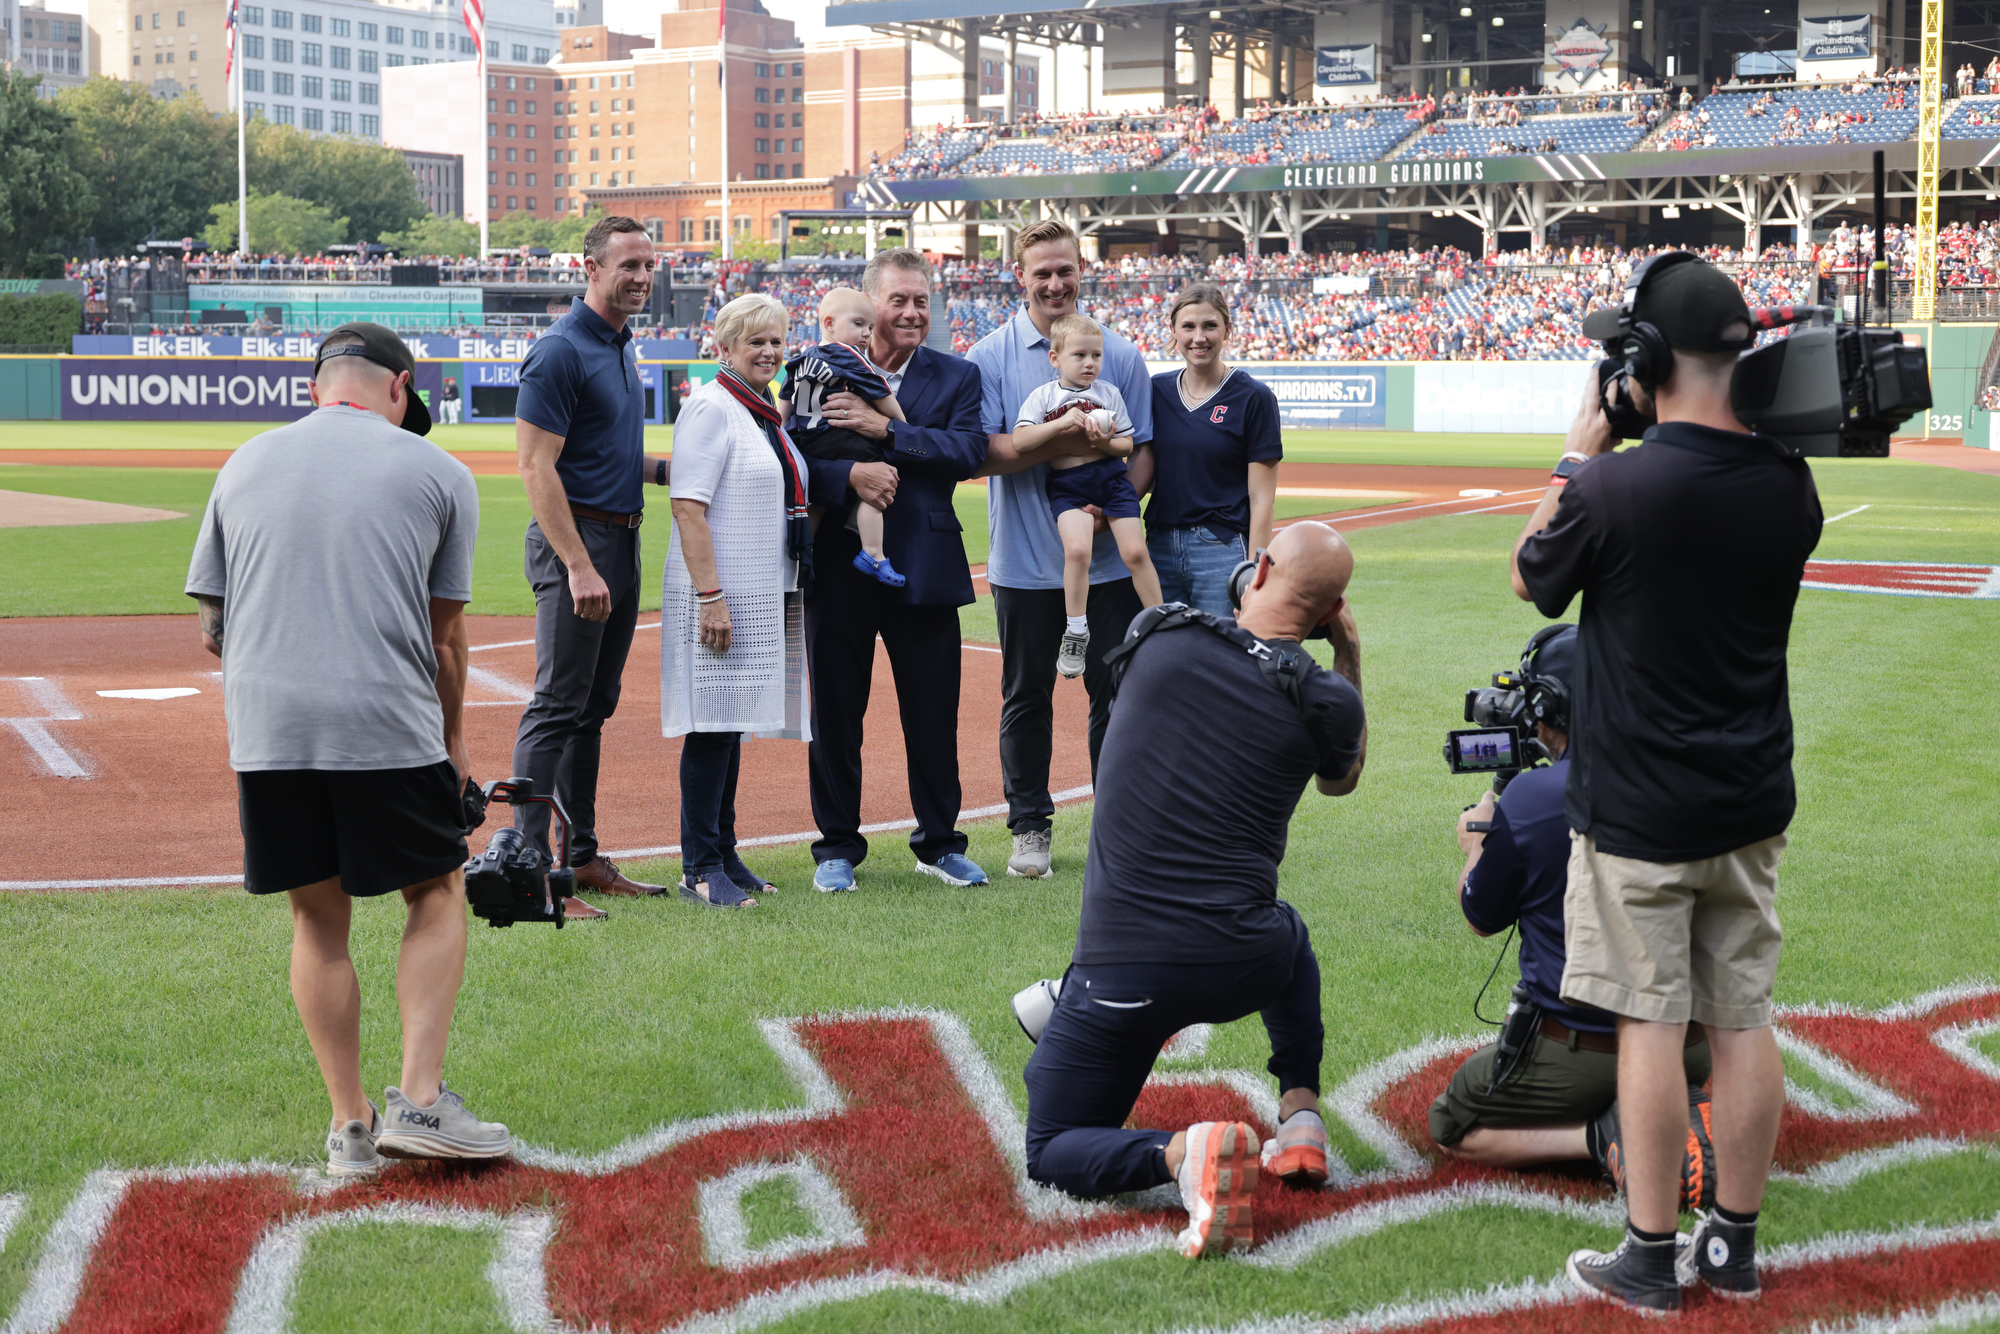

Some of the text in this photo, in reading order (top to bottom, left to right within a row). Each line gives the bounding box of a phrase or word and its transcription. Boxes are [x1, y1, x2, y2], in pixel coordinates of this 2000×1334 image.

[1554, 37, 1607, 55] FAMILY
[1803, 35, 1867, 47] Cleveland Clinic
[1815, 45, 1854, 55] Children's
[1318, 64, 1352, 74] Cleveland
[1561, 55, 1600, 70] DECK
[1328, 72, 1361, 82] Children's
[1284, 161, 1484, 188] CLEVELAND GUARDIANS
[201, 288, 478, 301] The Official Health Insurer of the Cleveland Guardians
[1210, 405, 1229, 424] C
[1930, 414, 1963, 431] 325
[399, 1110, 441, 1131] HOKA
